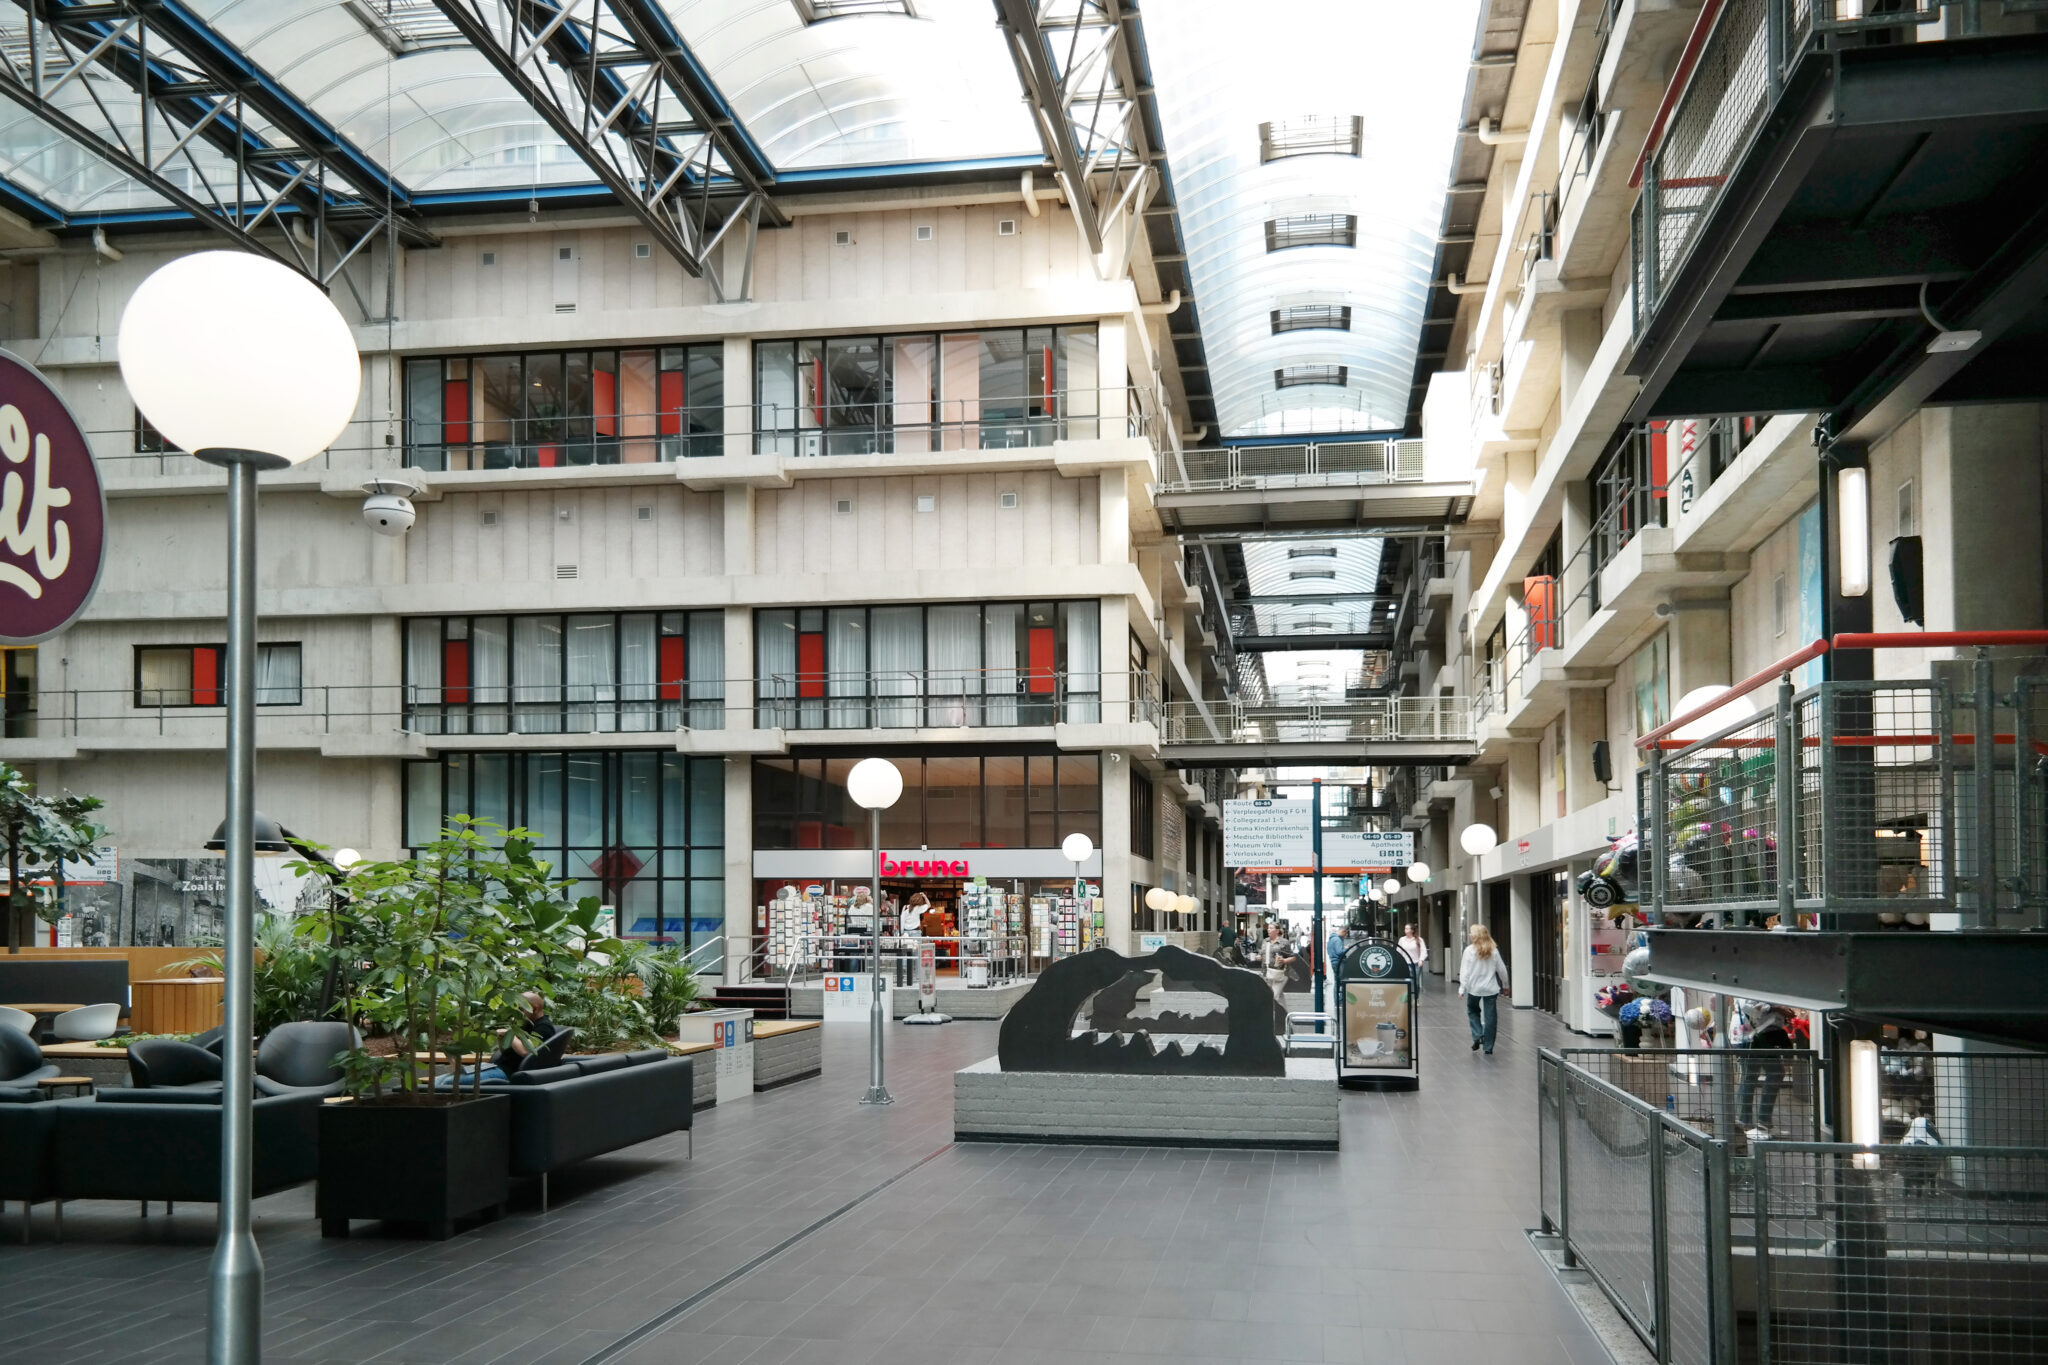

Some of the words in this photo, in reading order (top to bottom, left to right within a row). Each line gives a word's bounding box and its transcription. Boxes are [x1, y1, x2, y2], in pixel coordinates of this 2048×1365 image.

[1233, 808, 1288, 816] Verpleegafdeling
[880, 852, 969, 877] bruna
[182, 880, 214, 892] Zoals
